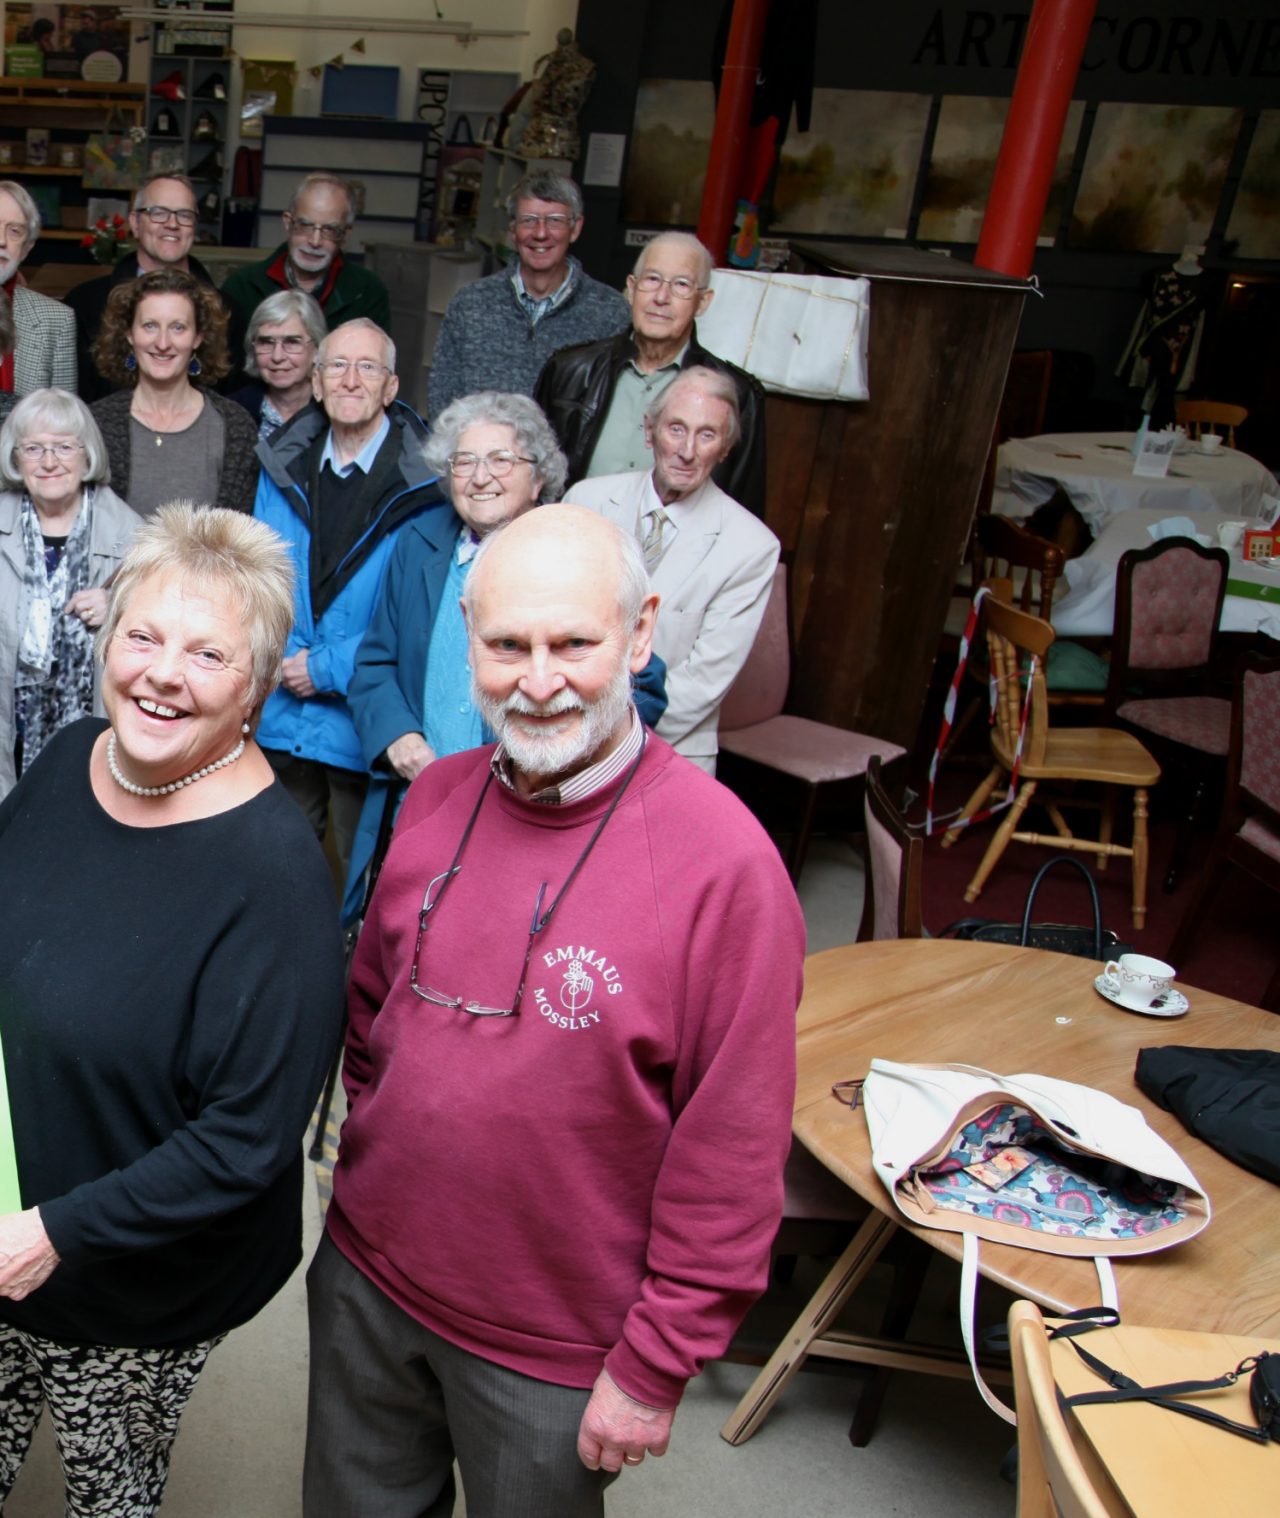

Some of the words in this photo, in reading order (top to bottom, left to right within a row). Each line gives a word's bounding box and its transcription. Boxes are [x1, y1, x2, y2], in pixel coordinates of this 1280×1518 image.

[912, 9, 1032, 68] ART
[542, 945, 623, 995] EMMAUS
[534, 987, 601, 1030] MOSSLEY
